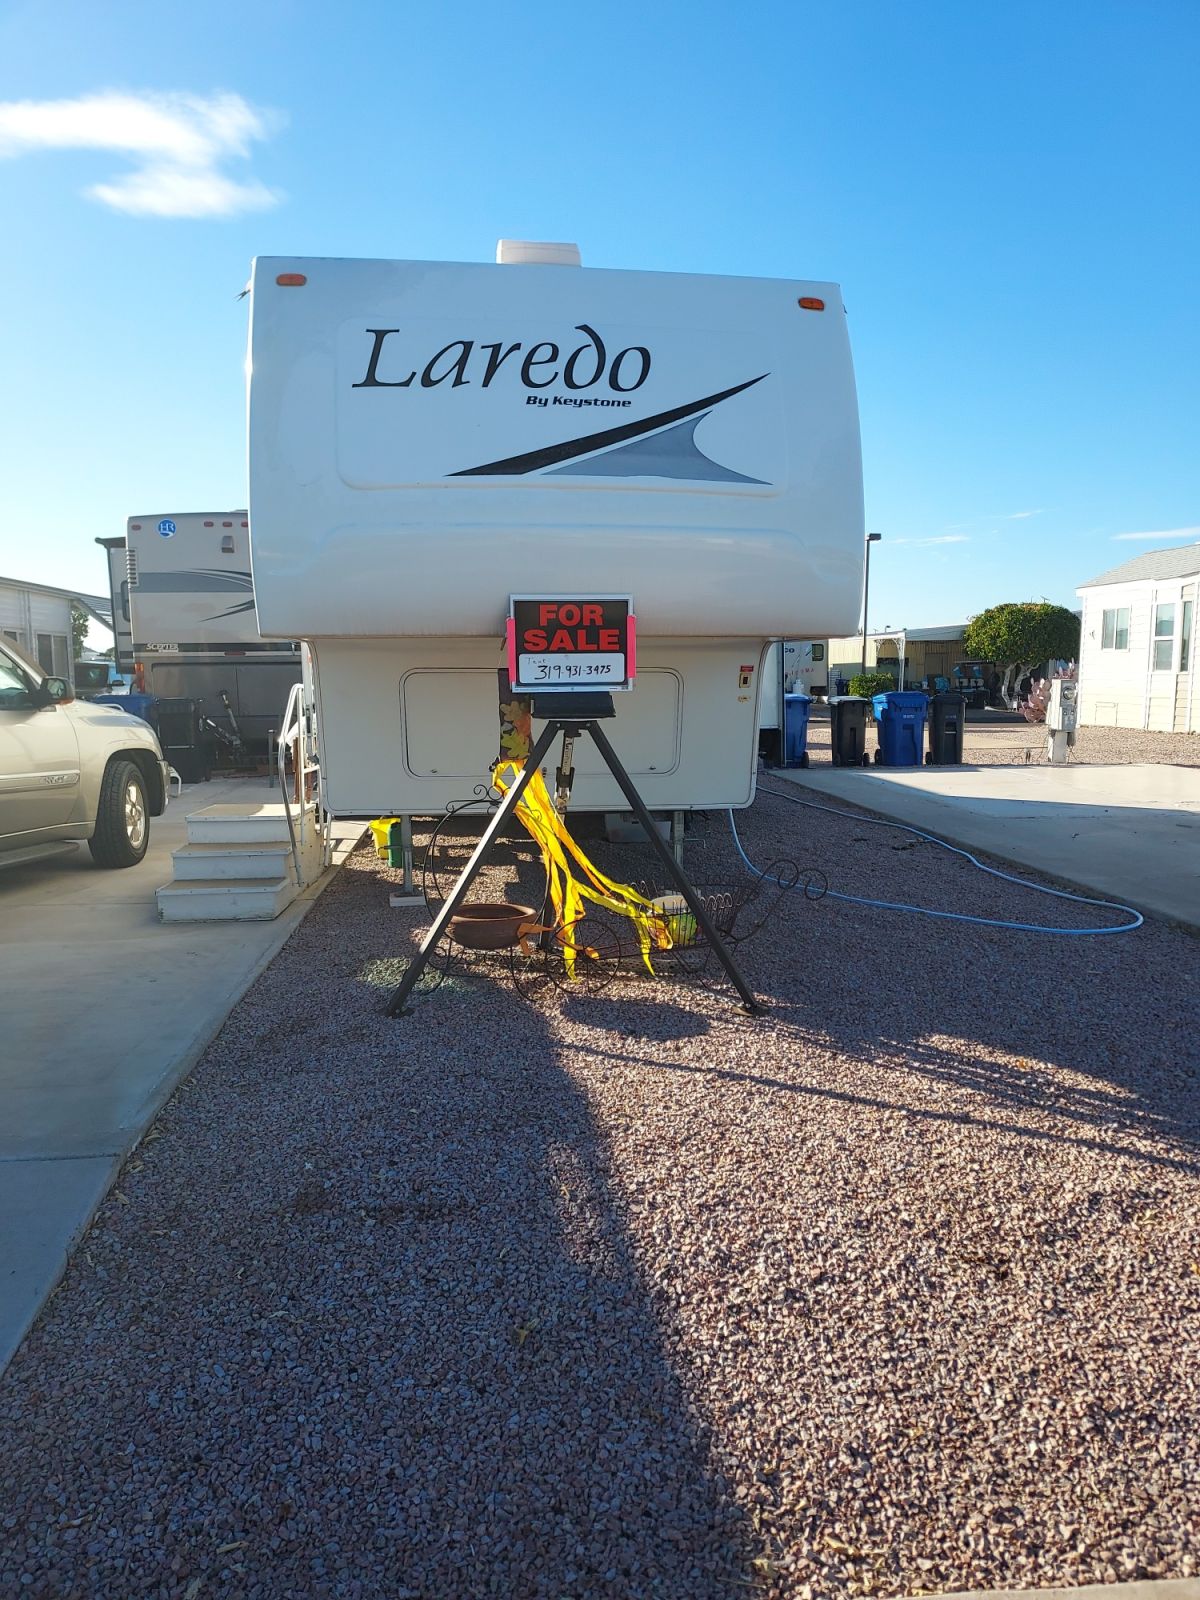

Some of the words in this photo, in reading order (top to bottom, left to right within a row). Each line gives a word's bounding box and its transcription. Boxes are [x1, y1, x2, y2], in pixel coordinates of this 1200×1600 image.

[352, 324, 651, 392] Laredo
[526, 395, 548, 407] By
[552, 396, 632, 408] Keystone
[539, 604, 604, 627] FOR
[523, 628, 620, 651] SALE
